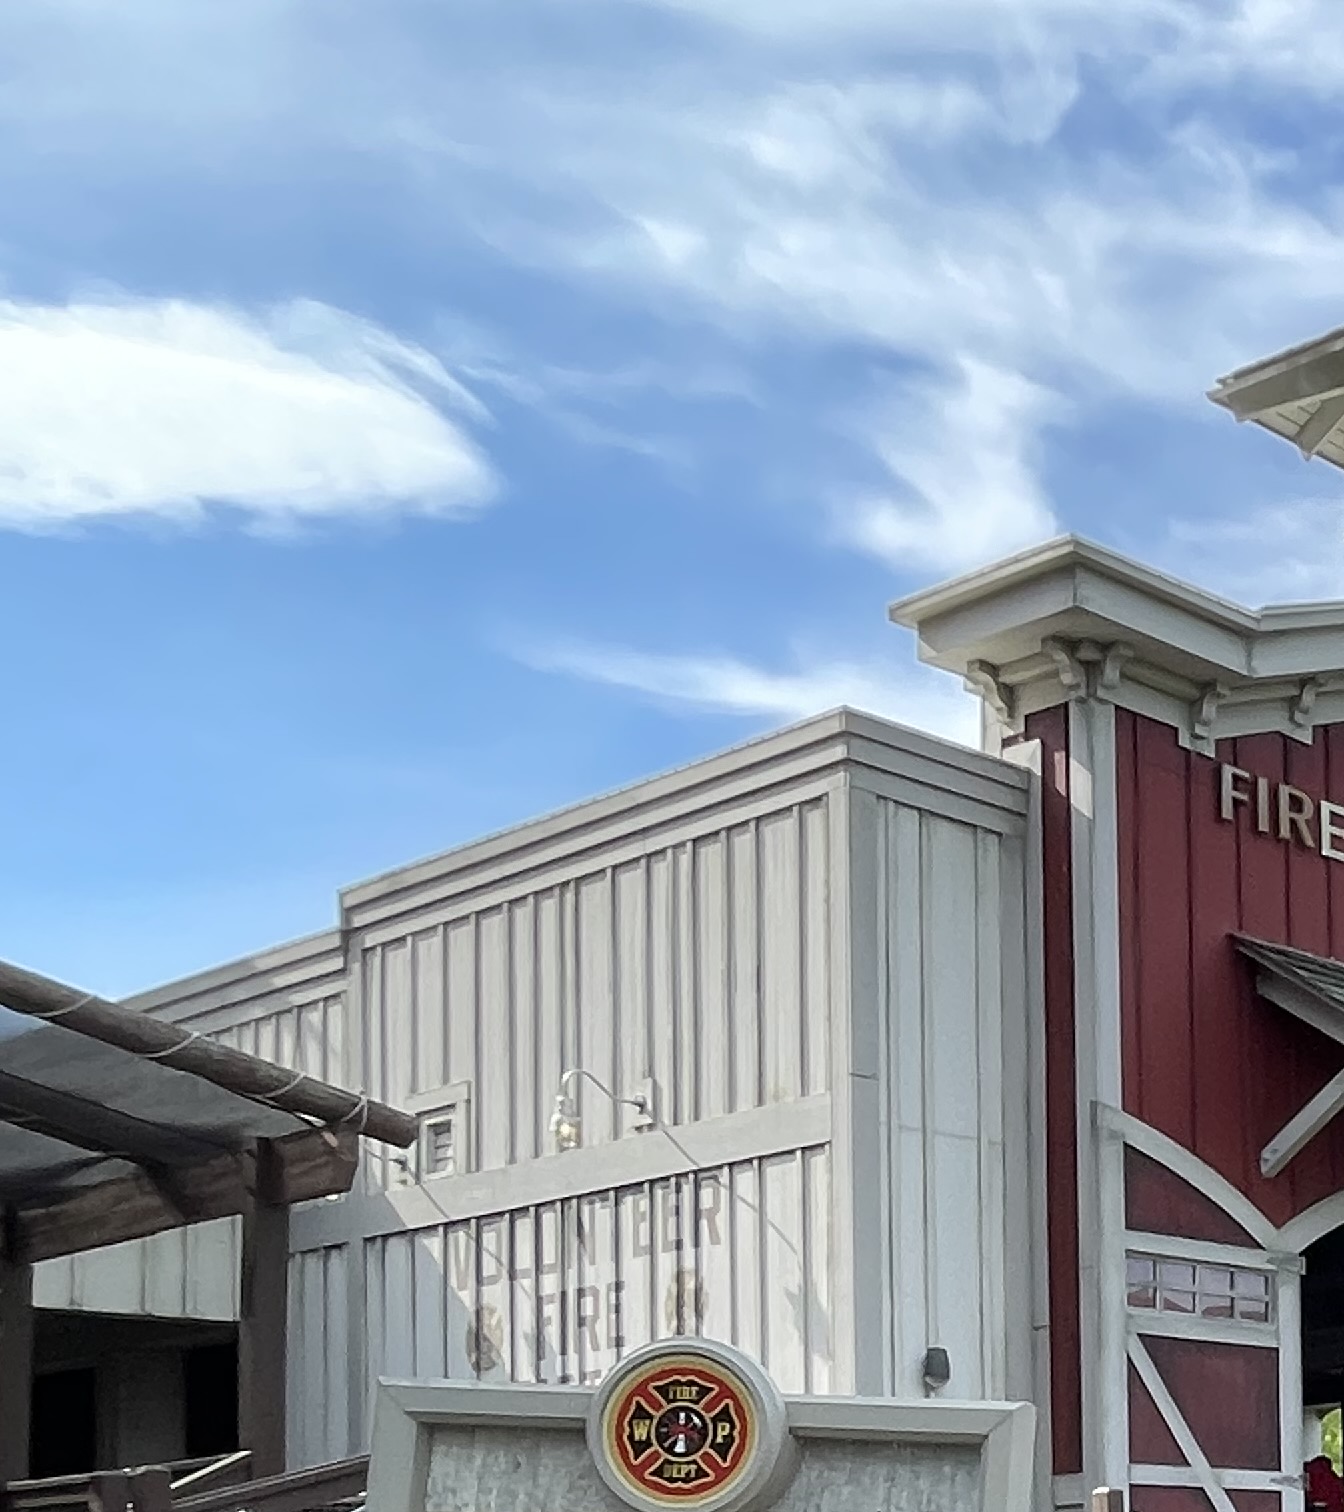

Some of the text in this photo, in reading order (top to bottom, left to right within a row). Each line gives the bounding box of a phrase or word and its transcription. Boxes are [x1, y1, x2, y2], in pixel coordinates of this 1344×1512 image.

[536, 1279, 626, 1362] FIRE
[632, 1419, 650, 1442] W
[716, 1422, 731, 1444] P
